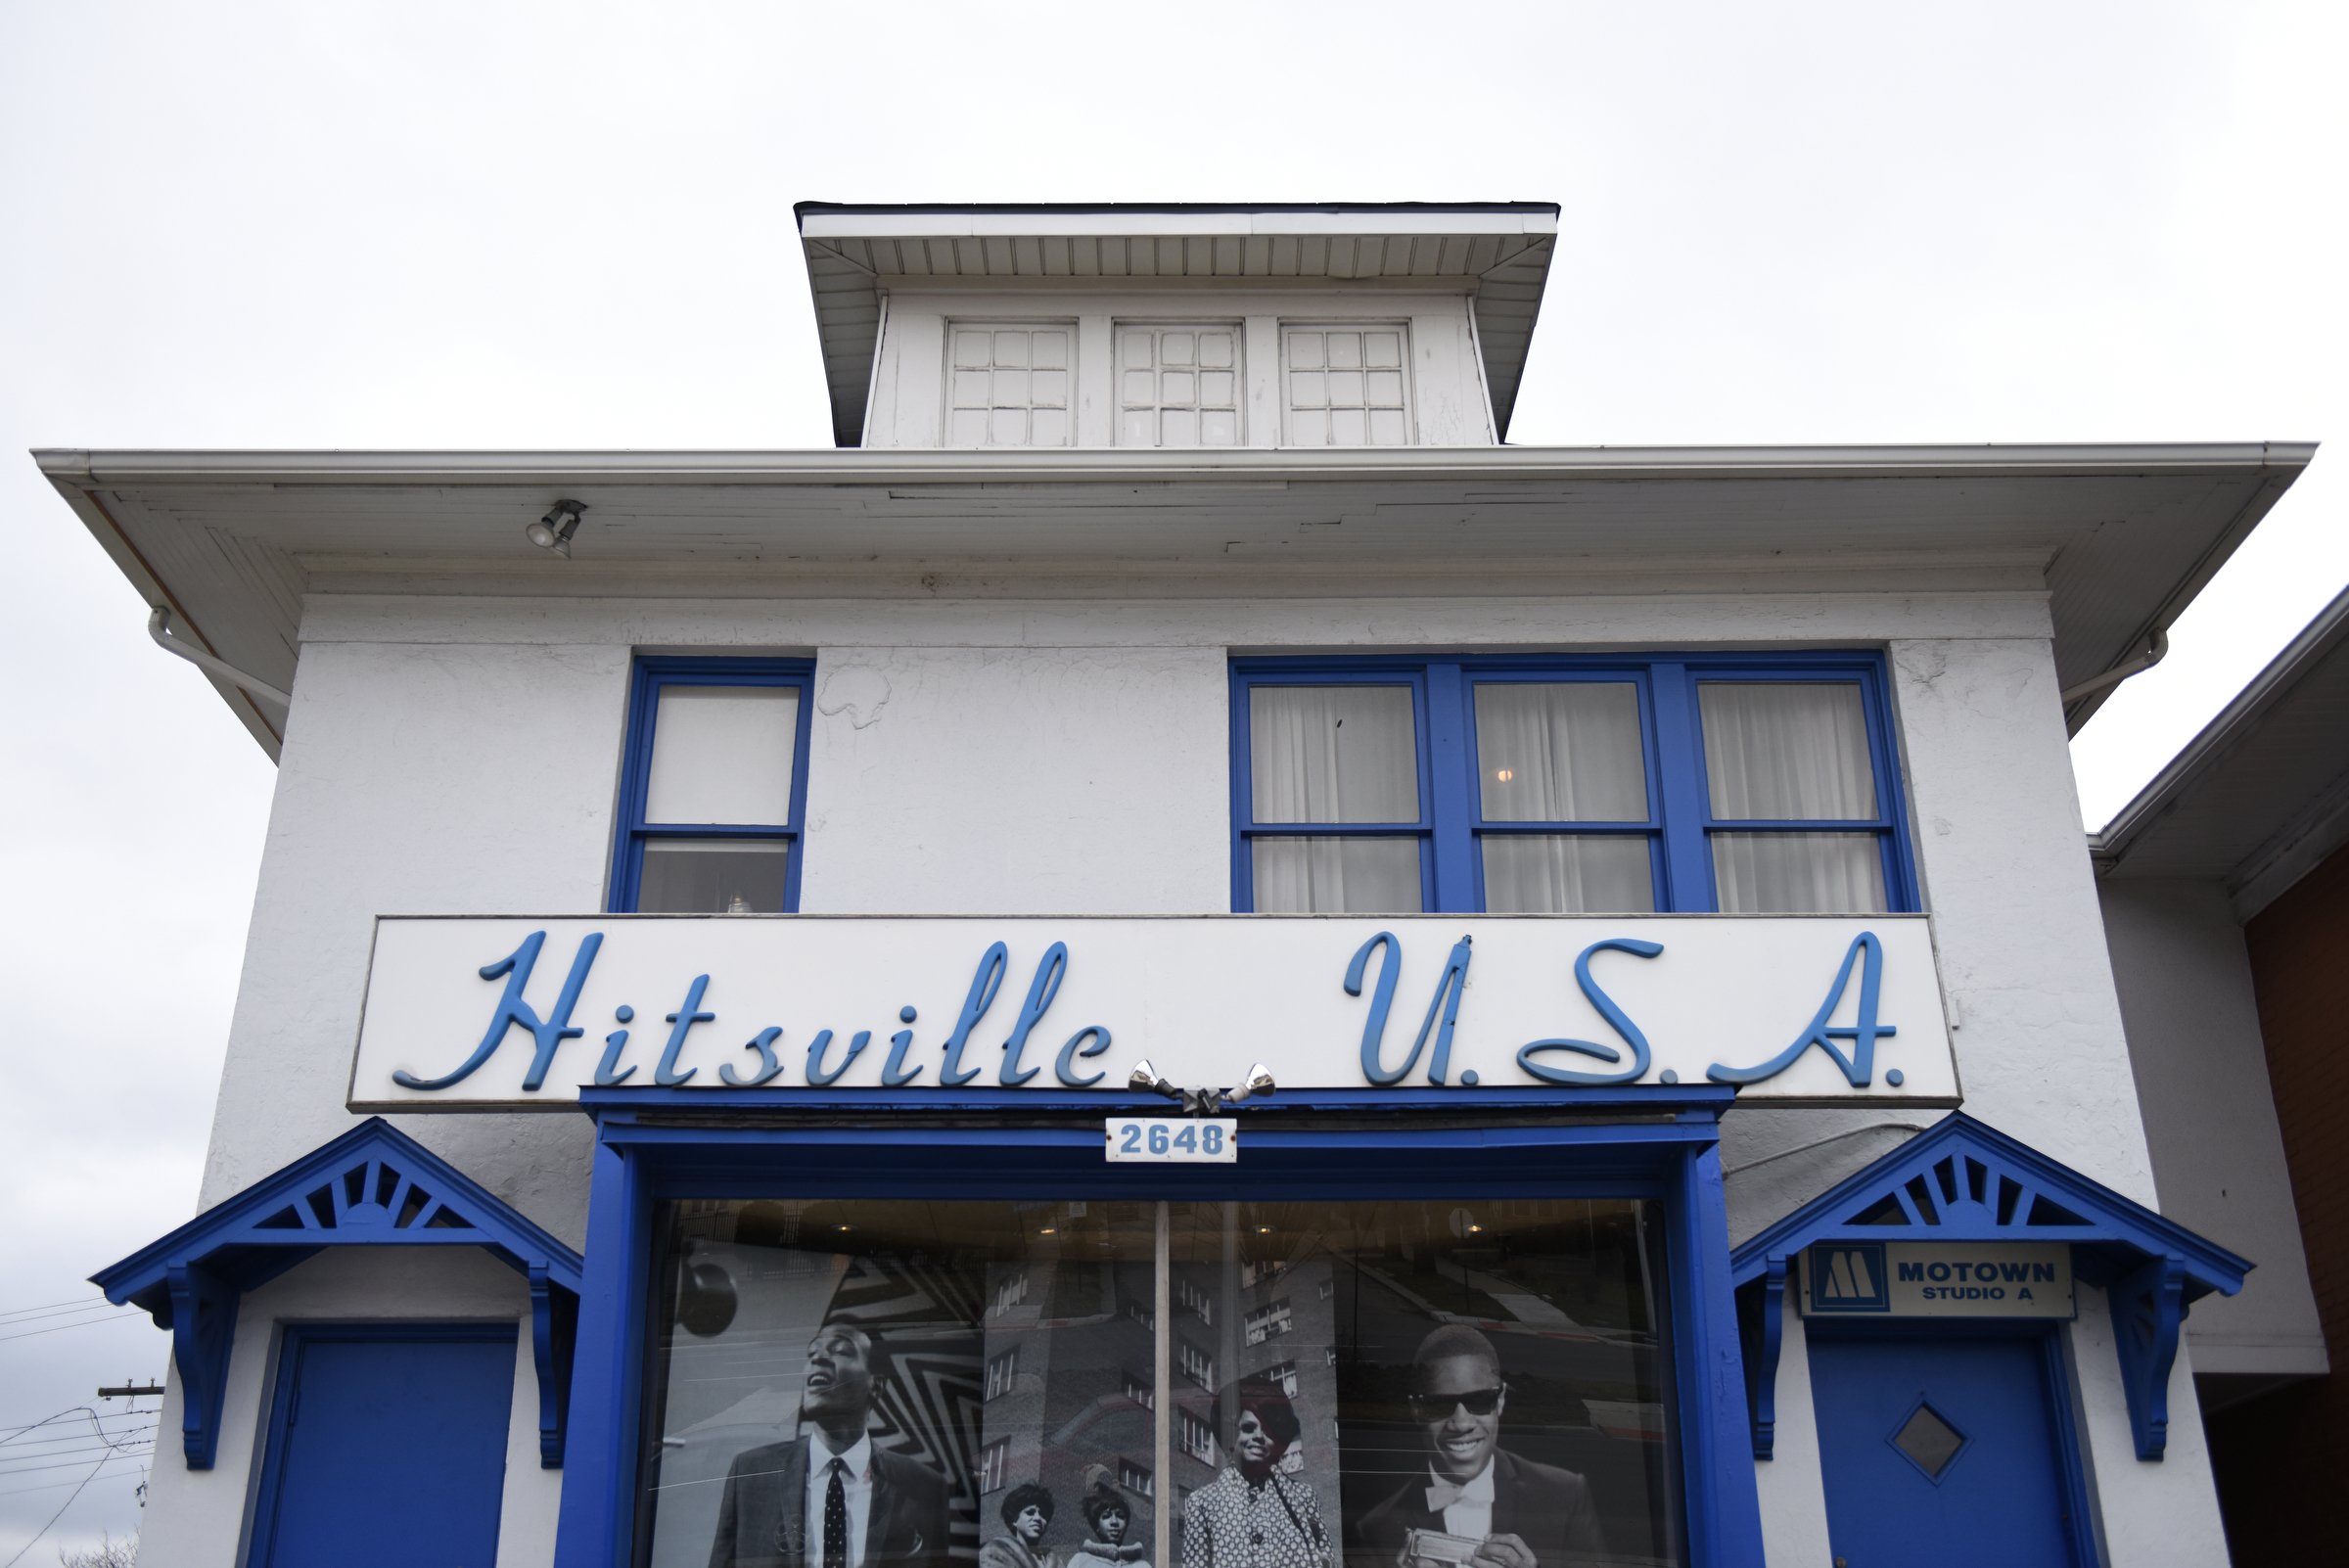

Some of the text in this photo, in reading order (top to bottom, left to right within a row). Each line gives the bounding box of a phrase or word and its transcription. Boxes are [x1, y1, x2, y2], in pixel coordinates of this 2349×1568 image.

[392, 930, 1113, 1091] Hitsville
[1121, 1124, 1223, 1155] 2648
[1898, 1262, 2055, 1282] MOTOWN
[1922, 1286, 2034, 1300] STUDIO A
